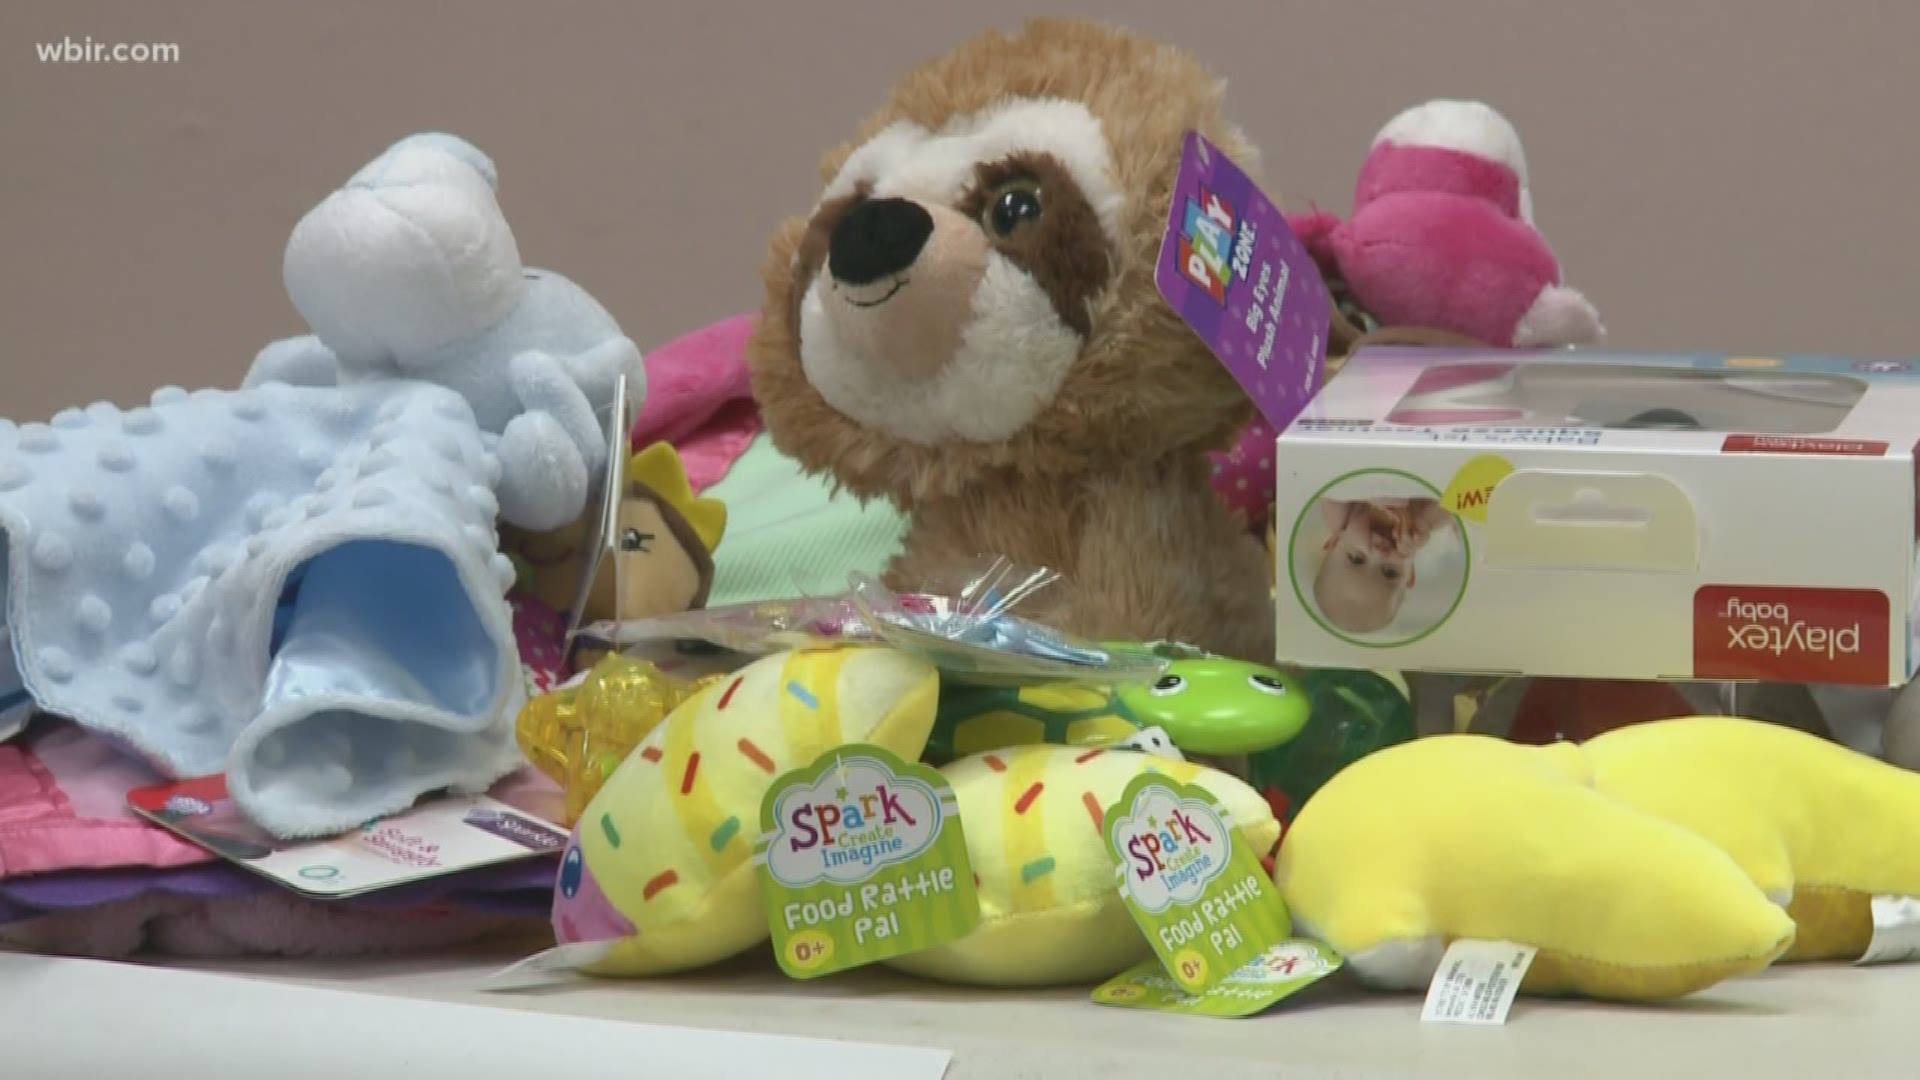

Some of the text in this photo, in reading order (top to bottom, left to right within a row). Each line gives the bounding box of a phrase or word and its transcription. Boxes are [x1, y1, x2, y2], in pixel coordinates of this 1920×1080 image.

[1188, 193, 1232, 288] PLAY
[1246, 261, 1271, 334] Big Eyes
[1257, 259, 1289, 370] Plush Animal
[1727, 596, 1788, 625] baby
[1728, 621, 1860, 660] playtex
[790, 784, 917, 852] Spark
[838, 825, 894, 848] Create
[821, 836, 903, 868] Imagine
[1128, 809, 1212, 882] Spark
[860, 867, 955, 912] Rattle
[1160, 854, 1212, 892] Imagine
[1201, 875, 1263, 925] Rattle
[854, 911, 899, 945] Pal
[1210, 924, 1243, 956] Pal
[794, 939, 825, 962] 0+
